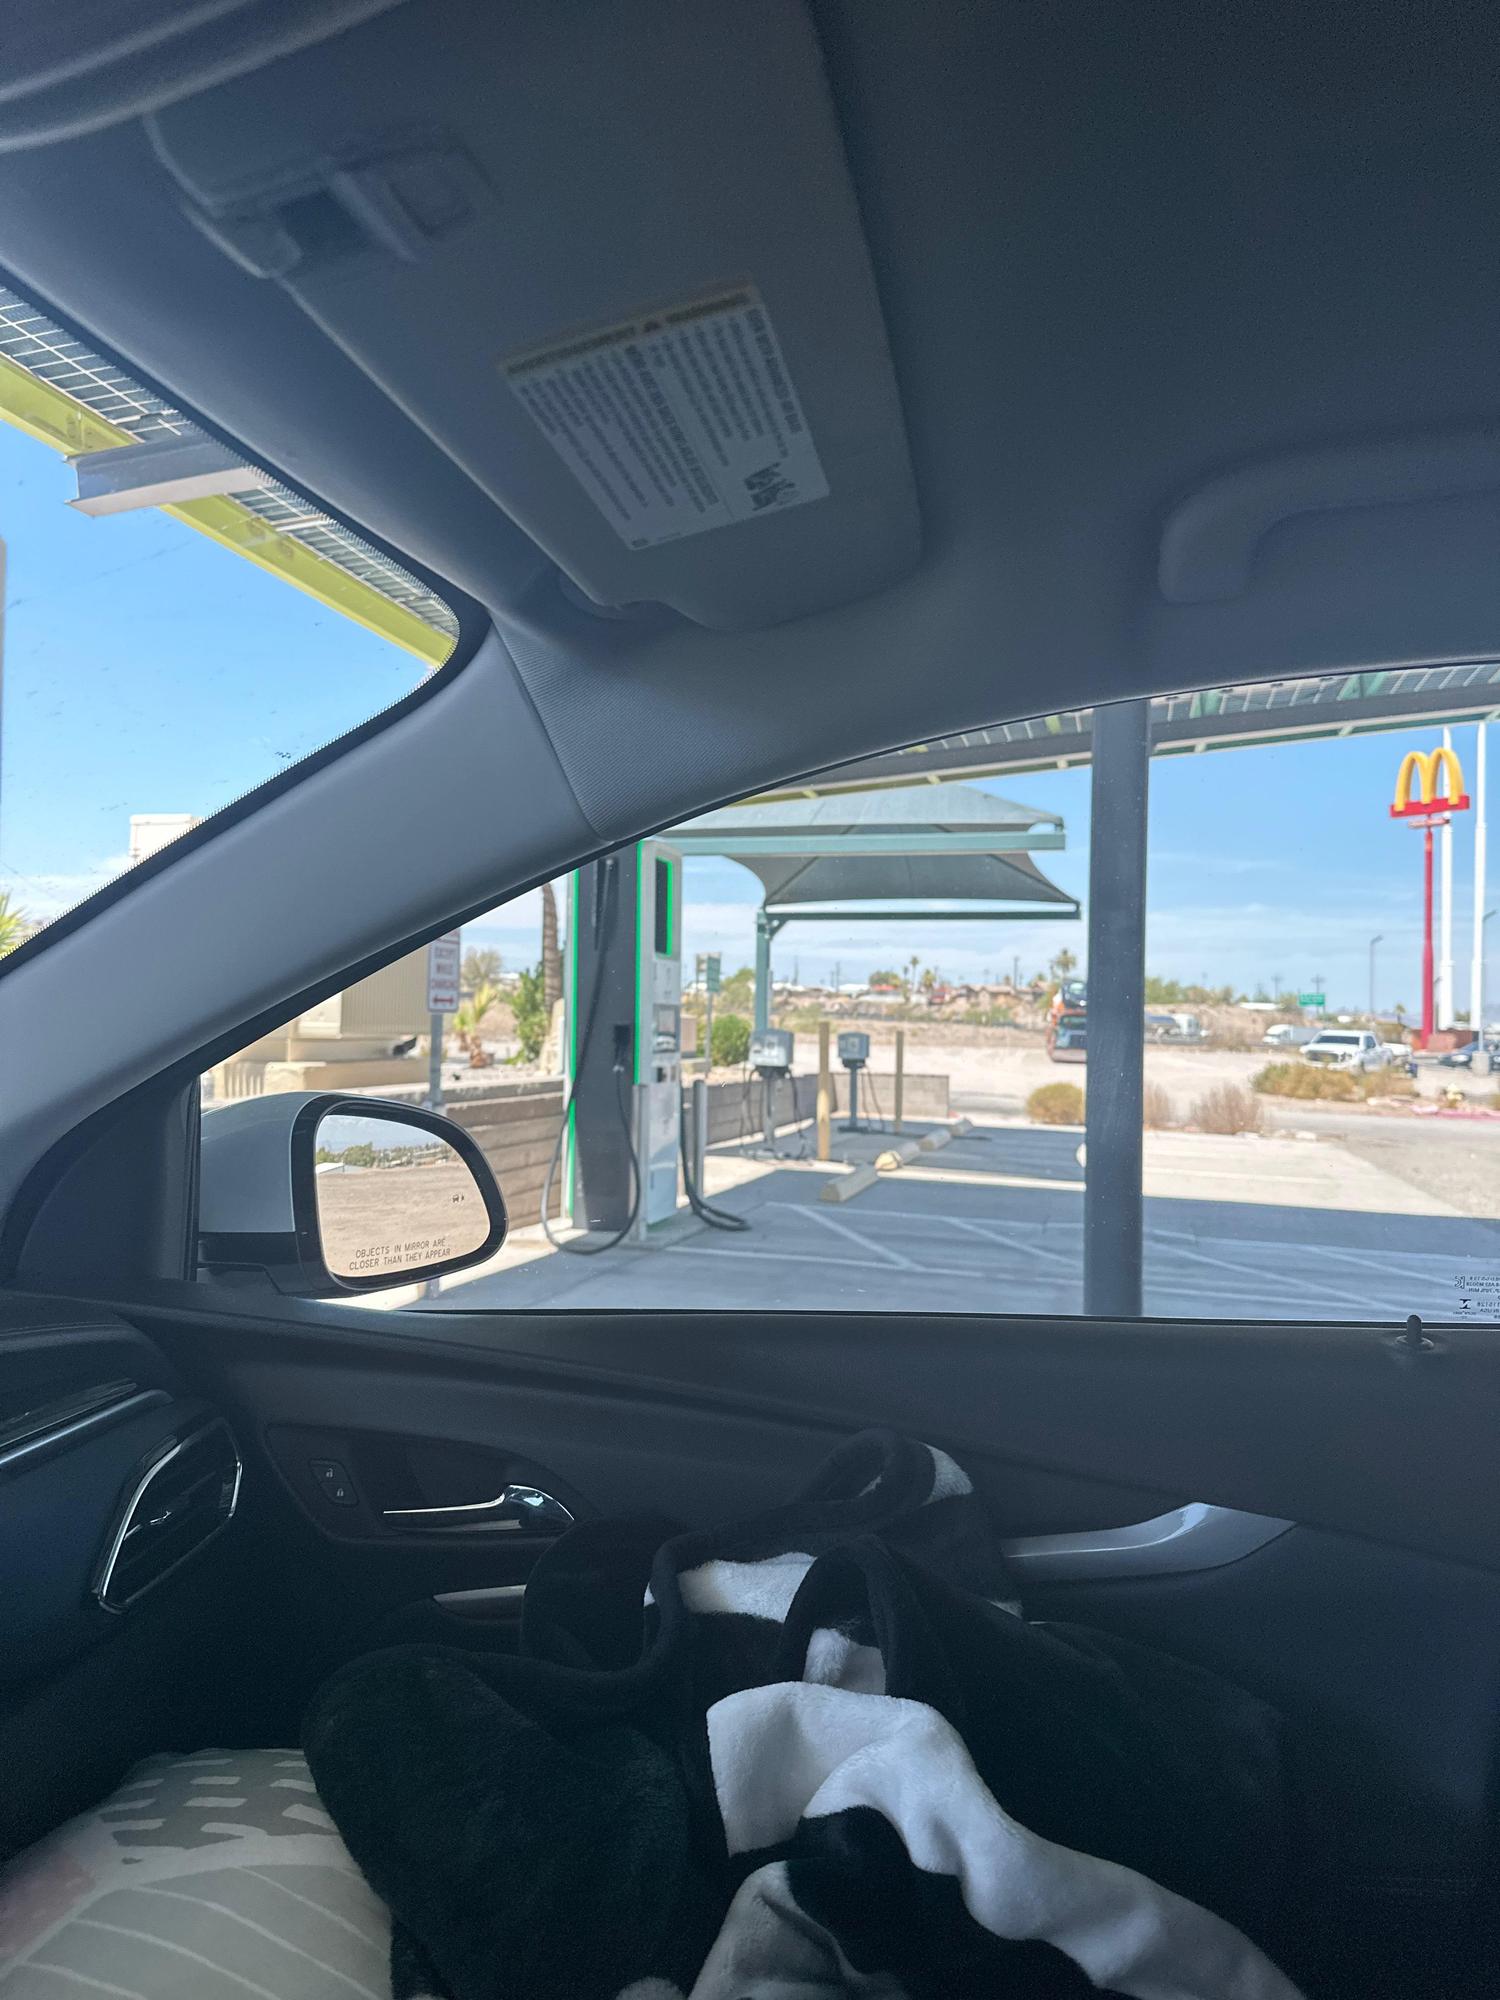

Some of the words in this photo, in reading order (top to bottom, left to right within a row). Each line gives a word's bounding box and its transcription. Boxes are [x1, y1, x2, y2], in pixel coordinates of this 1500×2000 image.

[355, 1246, 390, 1258] OBJECTS
[394, 1243, 401, 1253] IN
[404, 1240, 430, 1251] MIRROR
[432, 1238, 446, 1247] ARE
[349, 1258, 379, 1271] CLOSER
[383, 1255, 402, 1265] THAN
[405, 1252, 422, 1262] THEY
[425, 1248, 451, 1259] APPEAR
